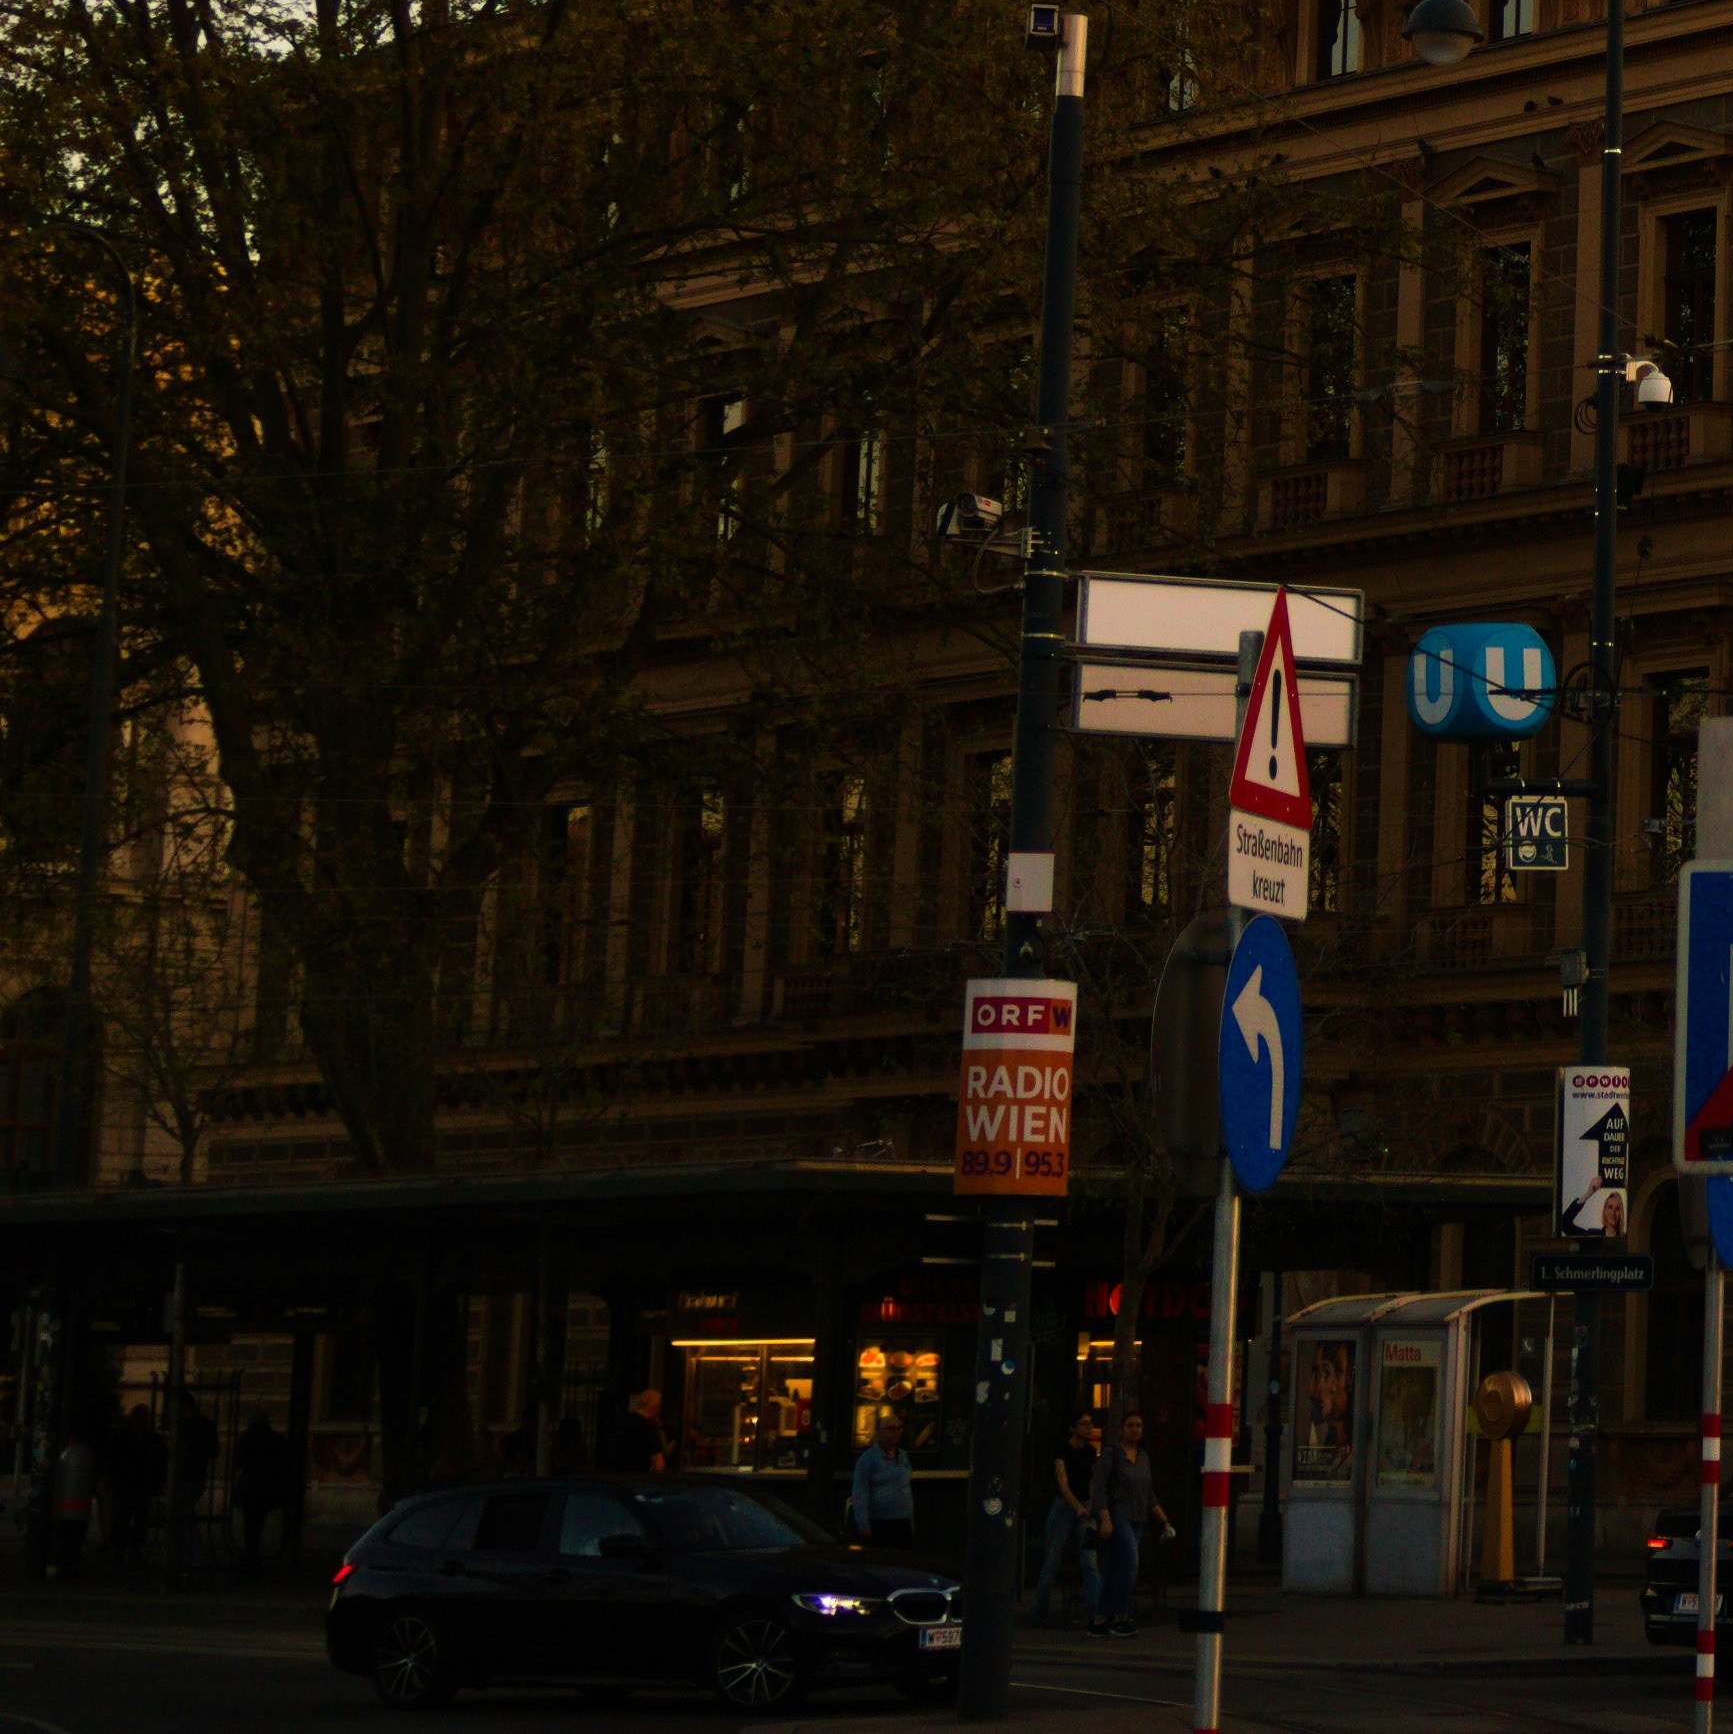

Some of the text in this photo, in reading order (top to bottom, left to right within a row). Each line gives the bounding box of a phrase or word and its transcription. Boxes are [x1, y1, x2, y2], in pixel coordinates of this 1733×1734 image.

[1413, 649, 1454, 725] U
[1485, 647, 1542, 721] U
[1515, 806, 1562, 837] WC
[1237, 824, 1303, 868] Straßenbahn
[1252, 869, 1285, 906] kreuzt
[977, 1004, 1071, 1028] ORF W
[967, 1065, 1070, 1101] RADIO
[965, 1105, 1068, 1144] WIEN
[1606, 1117, 1624, 1130] AUF
[962, 1151, 1012, 1177] 89.9
[1604, 1167, 1624, 1180] WEG
[1554, 1266, 1645, 1284] Schmerlingplatz
[1384, 1343, 1422, 1363] Matta
